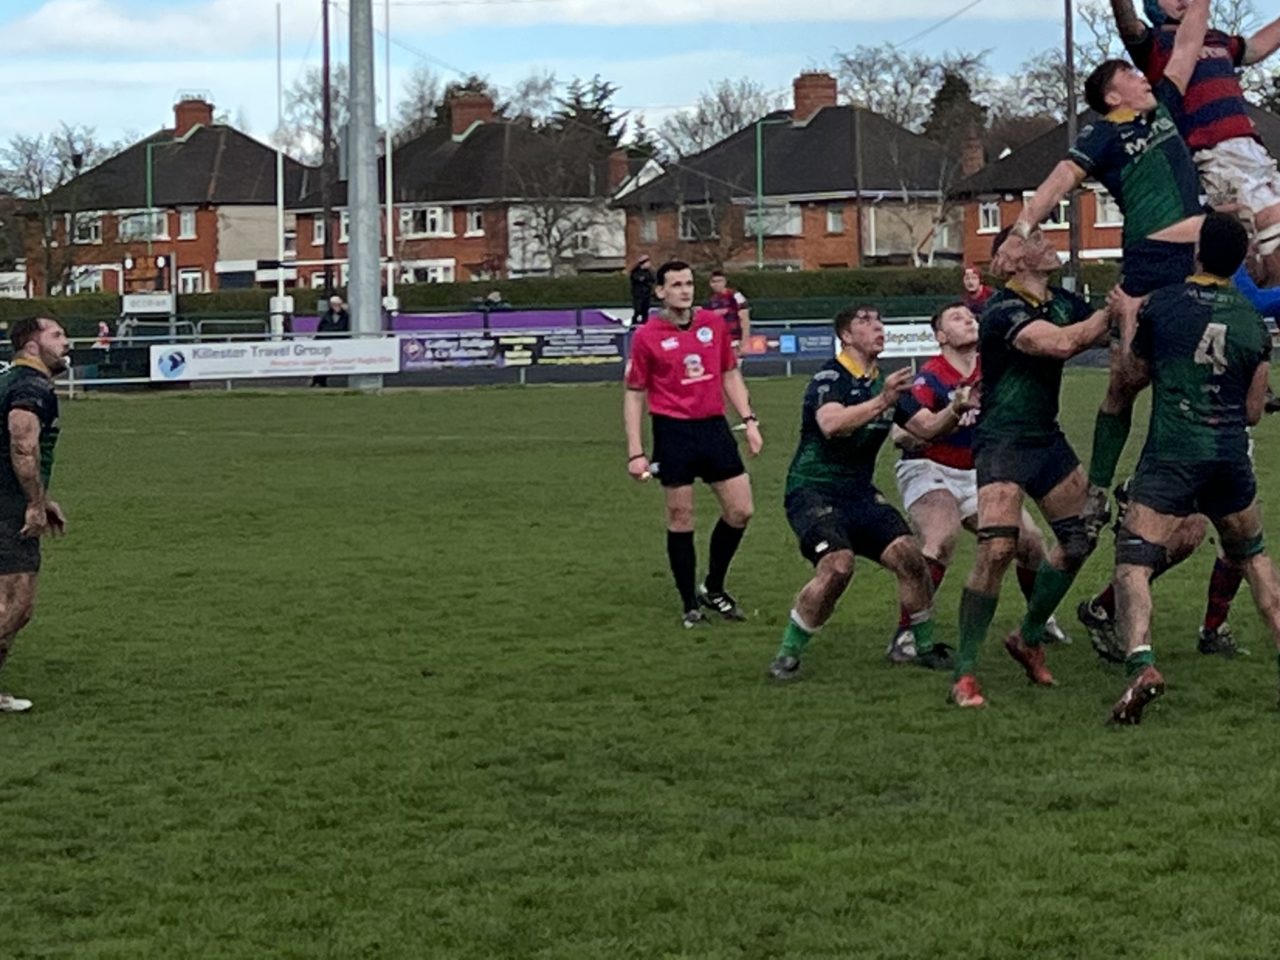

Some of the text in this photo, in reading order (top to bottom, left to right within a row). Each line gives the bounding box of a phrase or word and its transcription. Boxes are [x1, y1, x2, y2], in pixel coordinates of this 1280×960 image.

[192, 344, 332, 360] Killester Travel Group
[1194, 323, 1228, 375] 4
